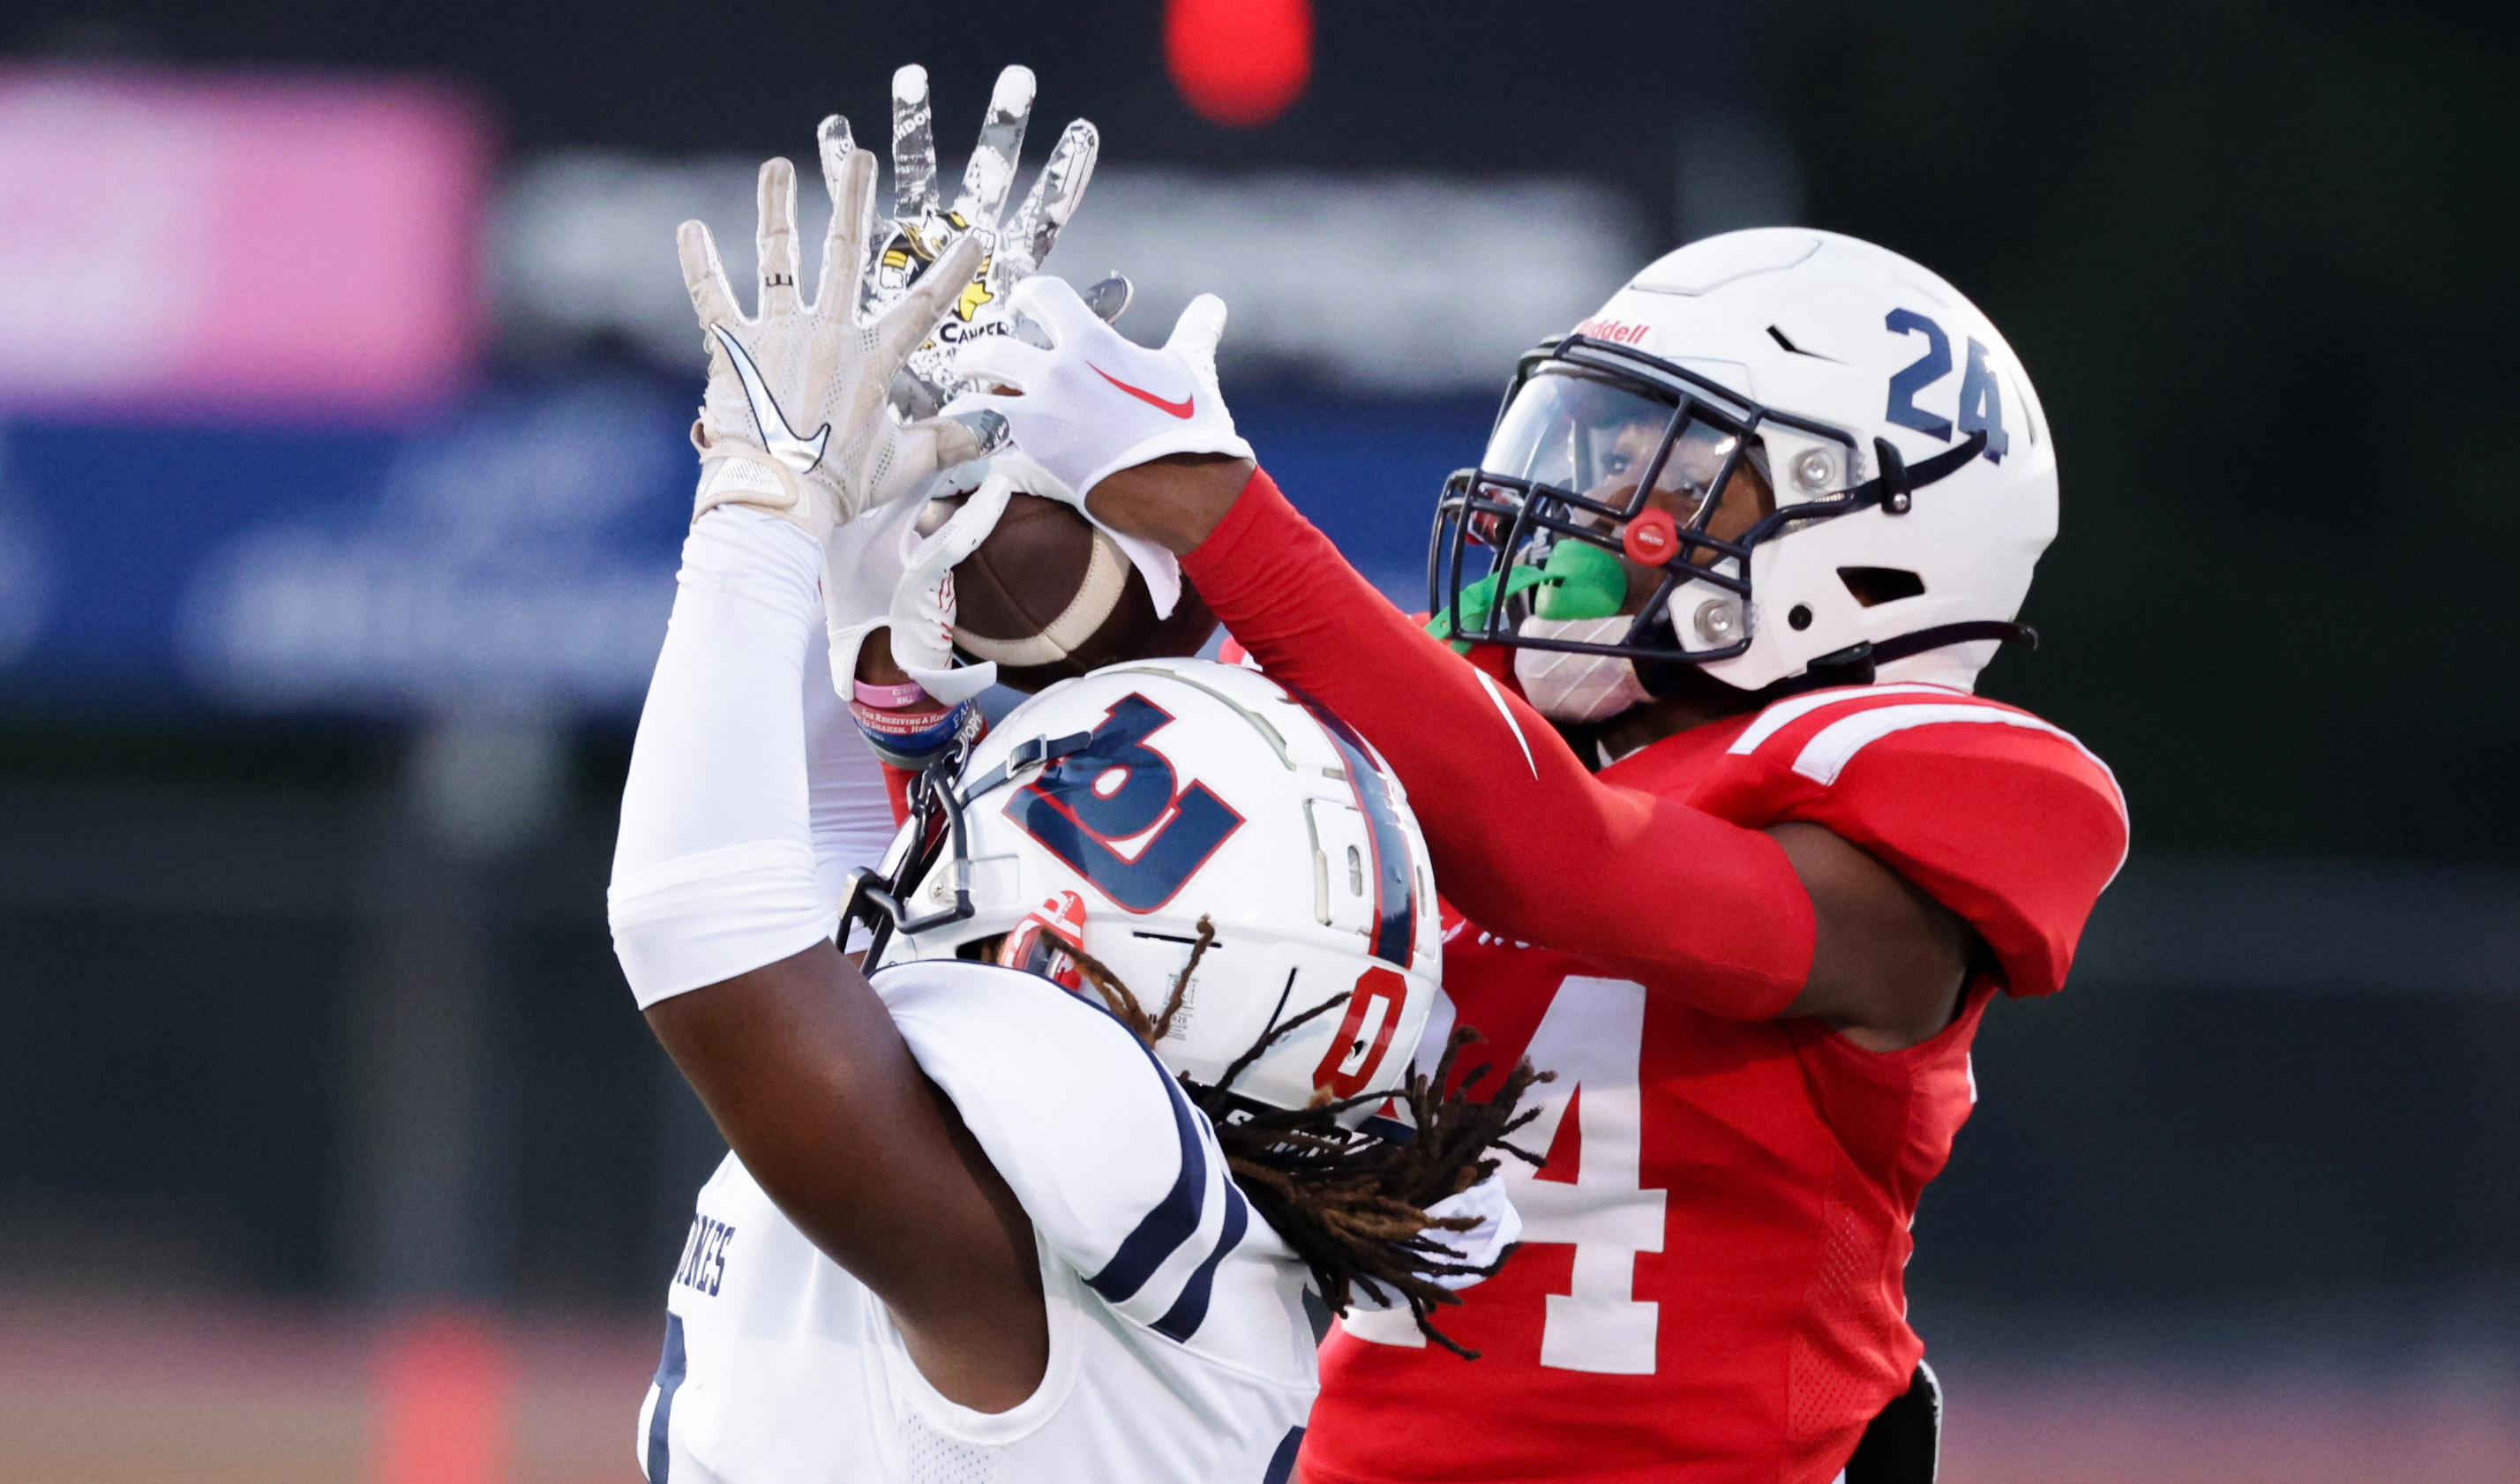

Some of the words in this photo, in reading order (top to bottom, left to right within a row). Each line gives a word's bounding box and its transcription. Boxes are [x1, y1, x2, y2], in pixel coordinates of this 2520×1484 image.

[1885, 307, 2008, 467] 24
[1313, 965, 1408, 1100] 0
[677, 1212, 736, 1298] ONES
